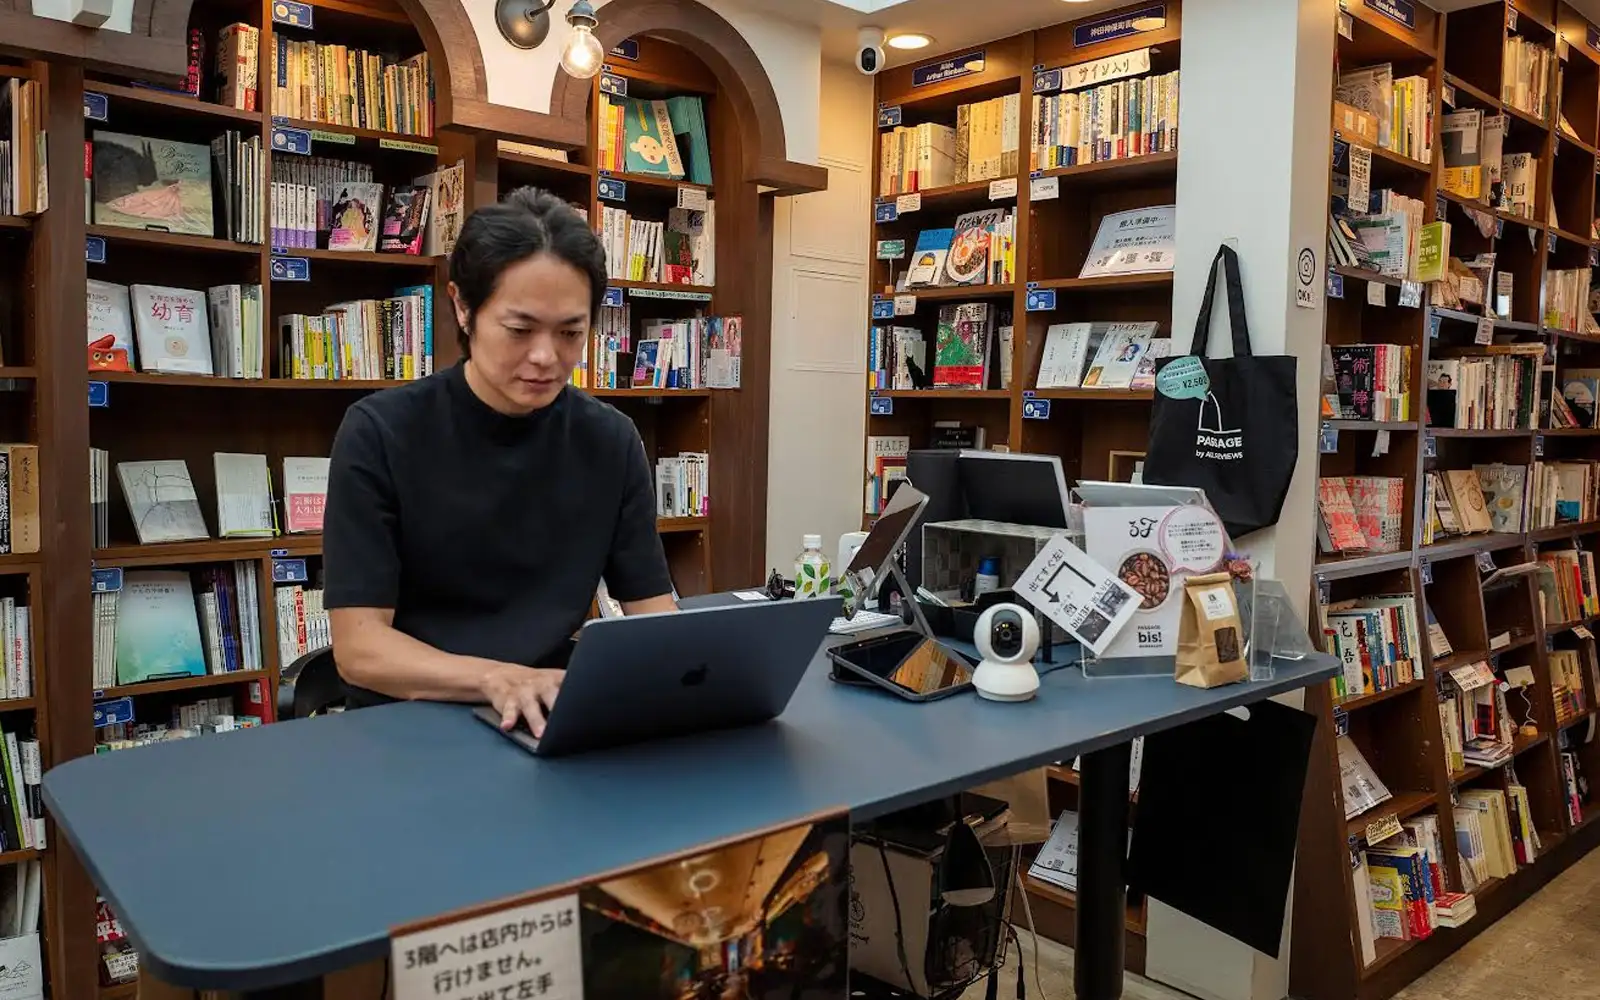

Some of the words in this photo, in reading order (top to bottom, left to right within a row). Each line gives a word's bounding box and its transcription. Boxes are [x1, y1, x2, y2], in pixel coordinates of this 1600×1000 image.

[151, 302, 194, 323] 幼育
[1197, 435, 1242, 448] PASSAGE
[1196, 450, 1205, 458] by
[1138, 631, 1162, 643] bis!
[404, 909, 574, 970] 3階へは店内からは
[433, 950, 543, 994] 行けません。
